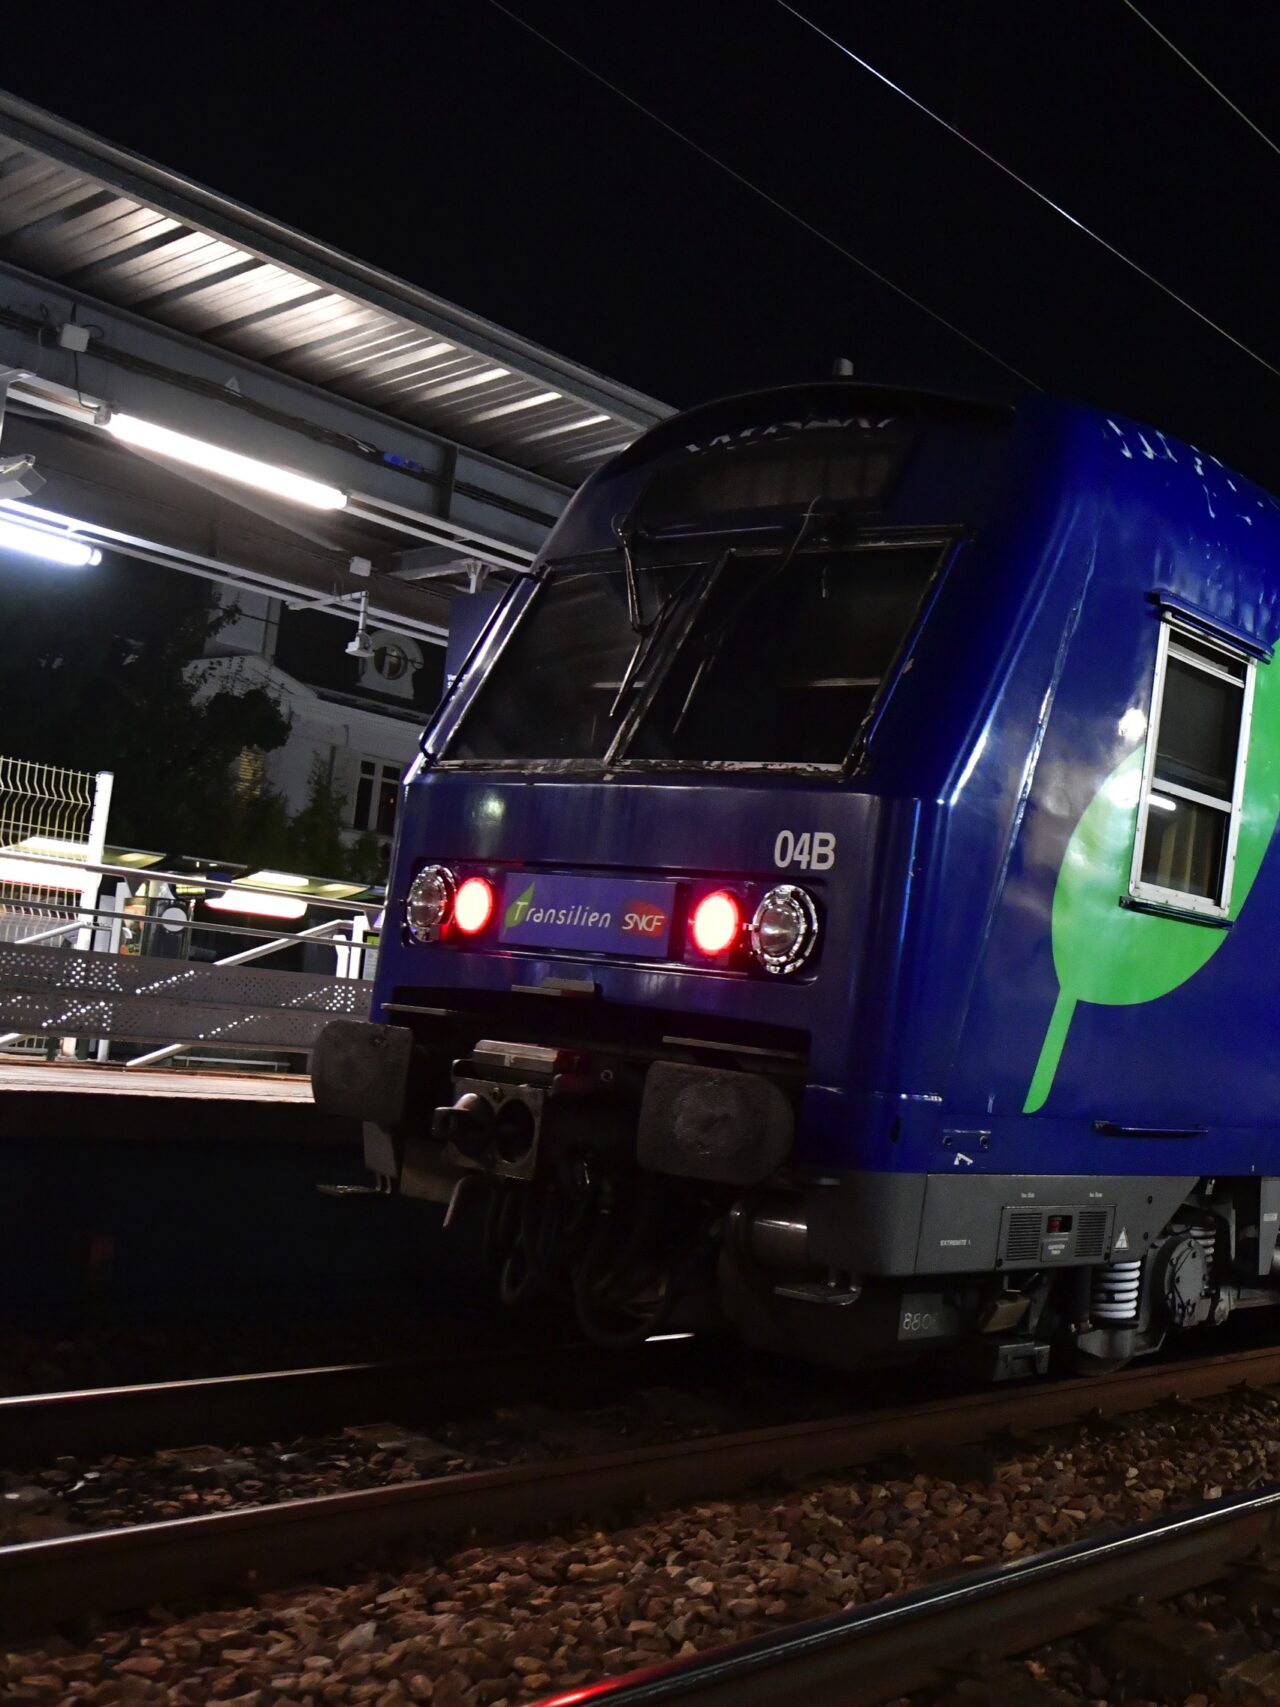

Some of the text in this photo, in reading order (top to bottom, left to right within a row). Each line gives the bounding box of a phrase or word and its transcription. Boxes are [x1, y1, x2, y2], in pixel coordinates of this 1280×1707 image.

[774, 829, 836, 870] 04B
[514, 901, 665, 931] Transilien SNCF
